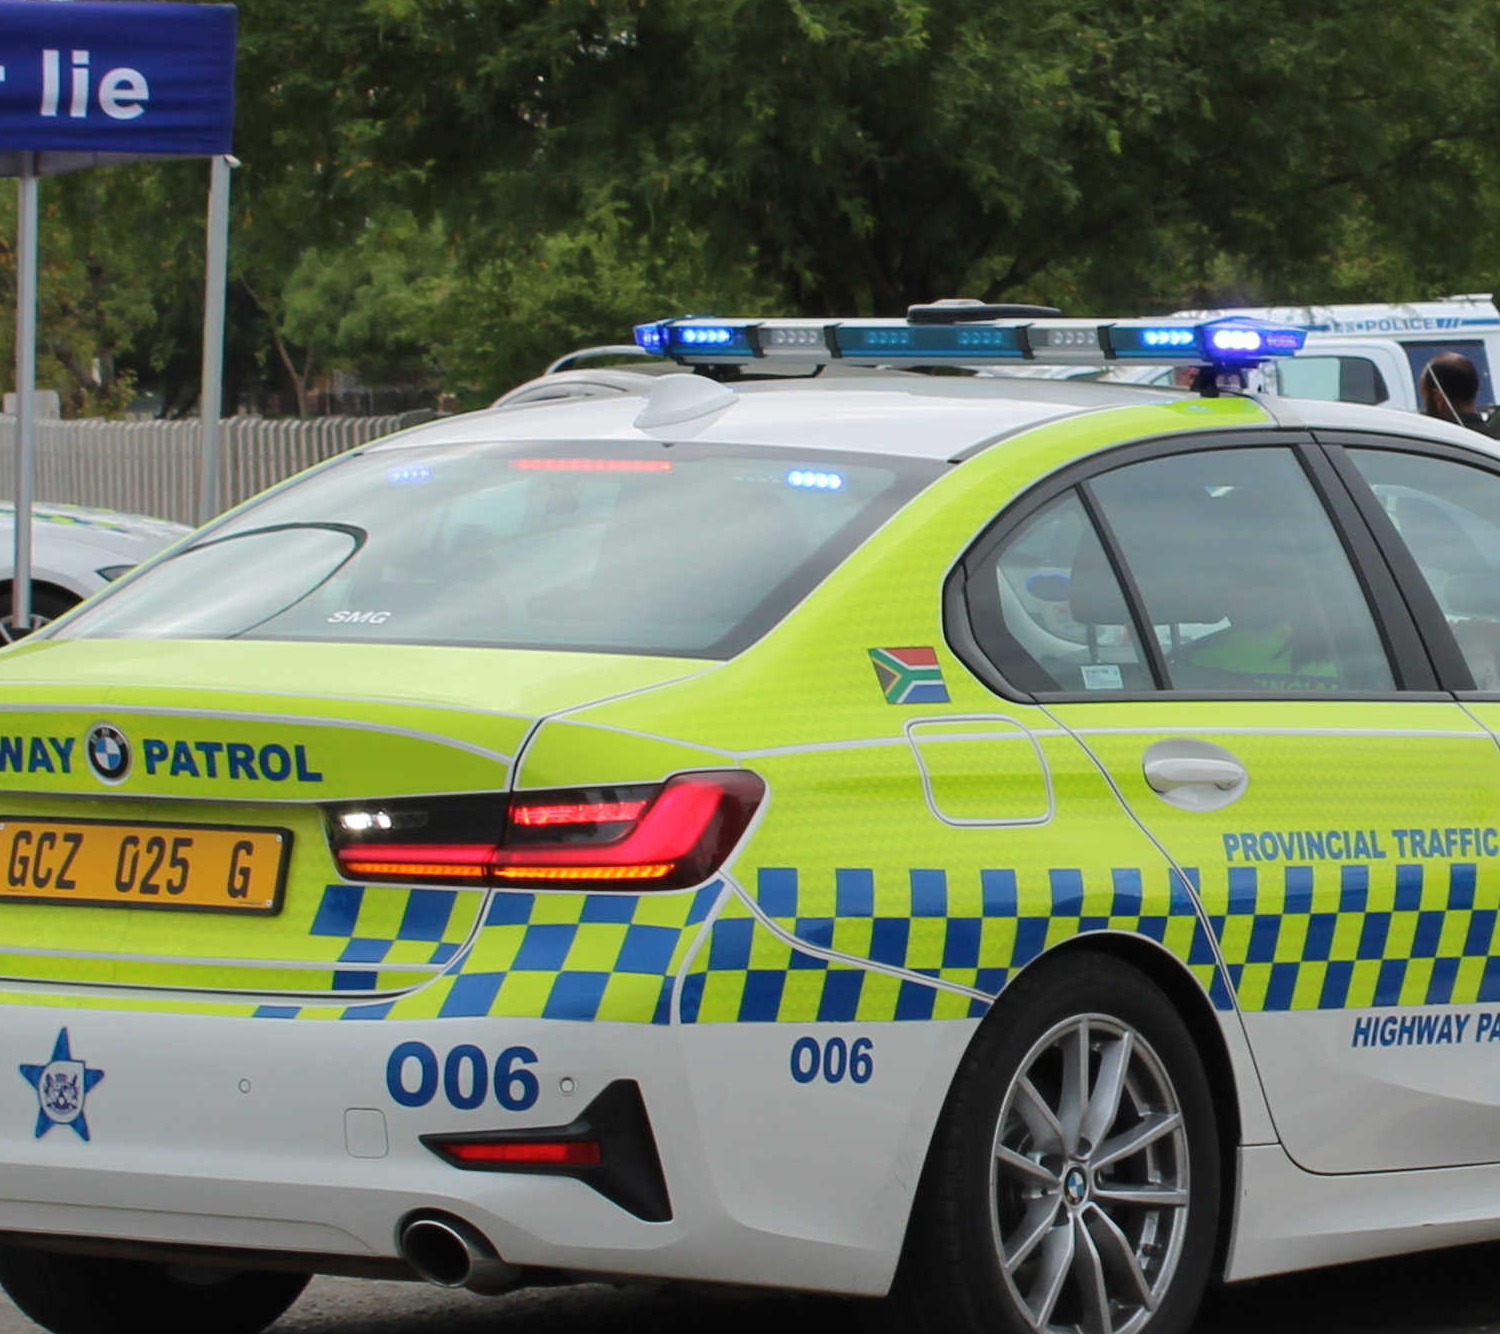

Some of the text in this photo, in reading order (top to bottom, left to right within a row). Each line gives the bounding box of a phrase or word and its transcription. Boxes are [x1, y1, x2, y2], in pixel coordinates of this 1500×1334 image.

[40, 49, 150, 121] lie
[1365, 318, 1437, 332] POLICE
[327, 609, 392, 625] SMG
[143, 738, 324, 783] PATROL
[1222, 827, 1500, 862] PROVINCIAL TRAFFIC
[6, 829, 256, 900] GCZ 025 G
[1351, 1013, 1471, 1048] HIGHWAY
